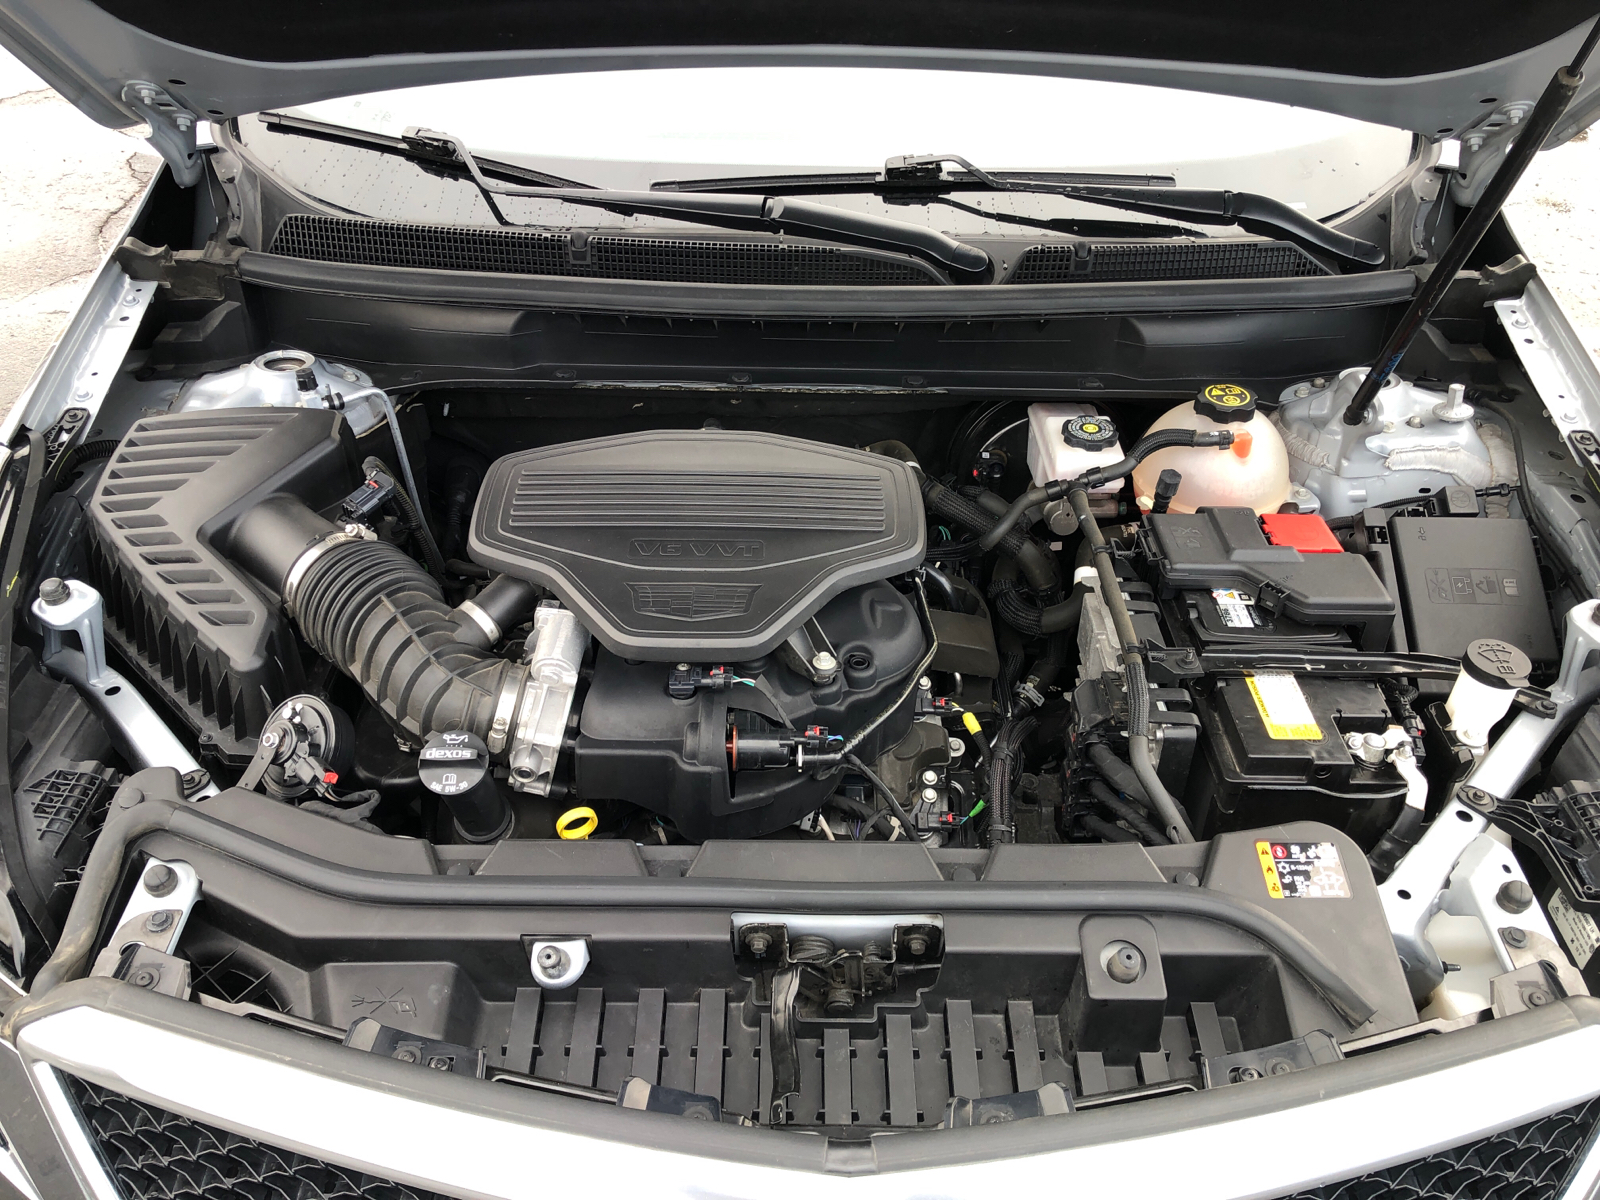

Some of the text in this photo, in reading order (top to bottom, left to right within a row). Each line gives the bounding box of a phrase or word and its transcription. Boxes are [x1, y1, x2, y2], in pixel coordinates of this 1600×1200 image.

[634, 541, 760, 557] V6 VVT
[426, 748, 472, 758] dexos
[430, 781, 443, 791] SAE
